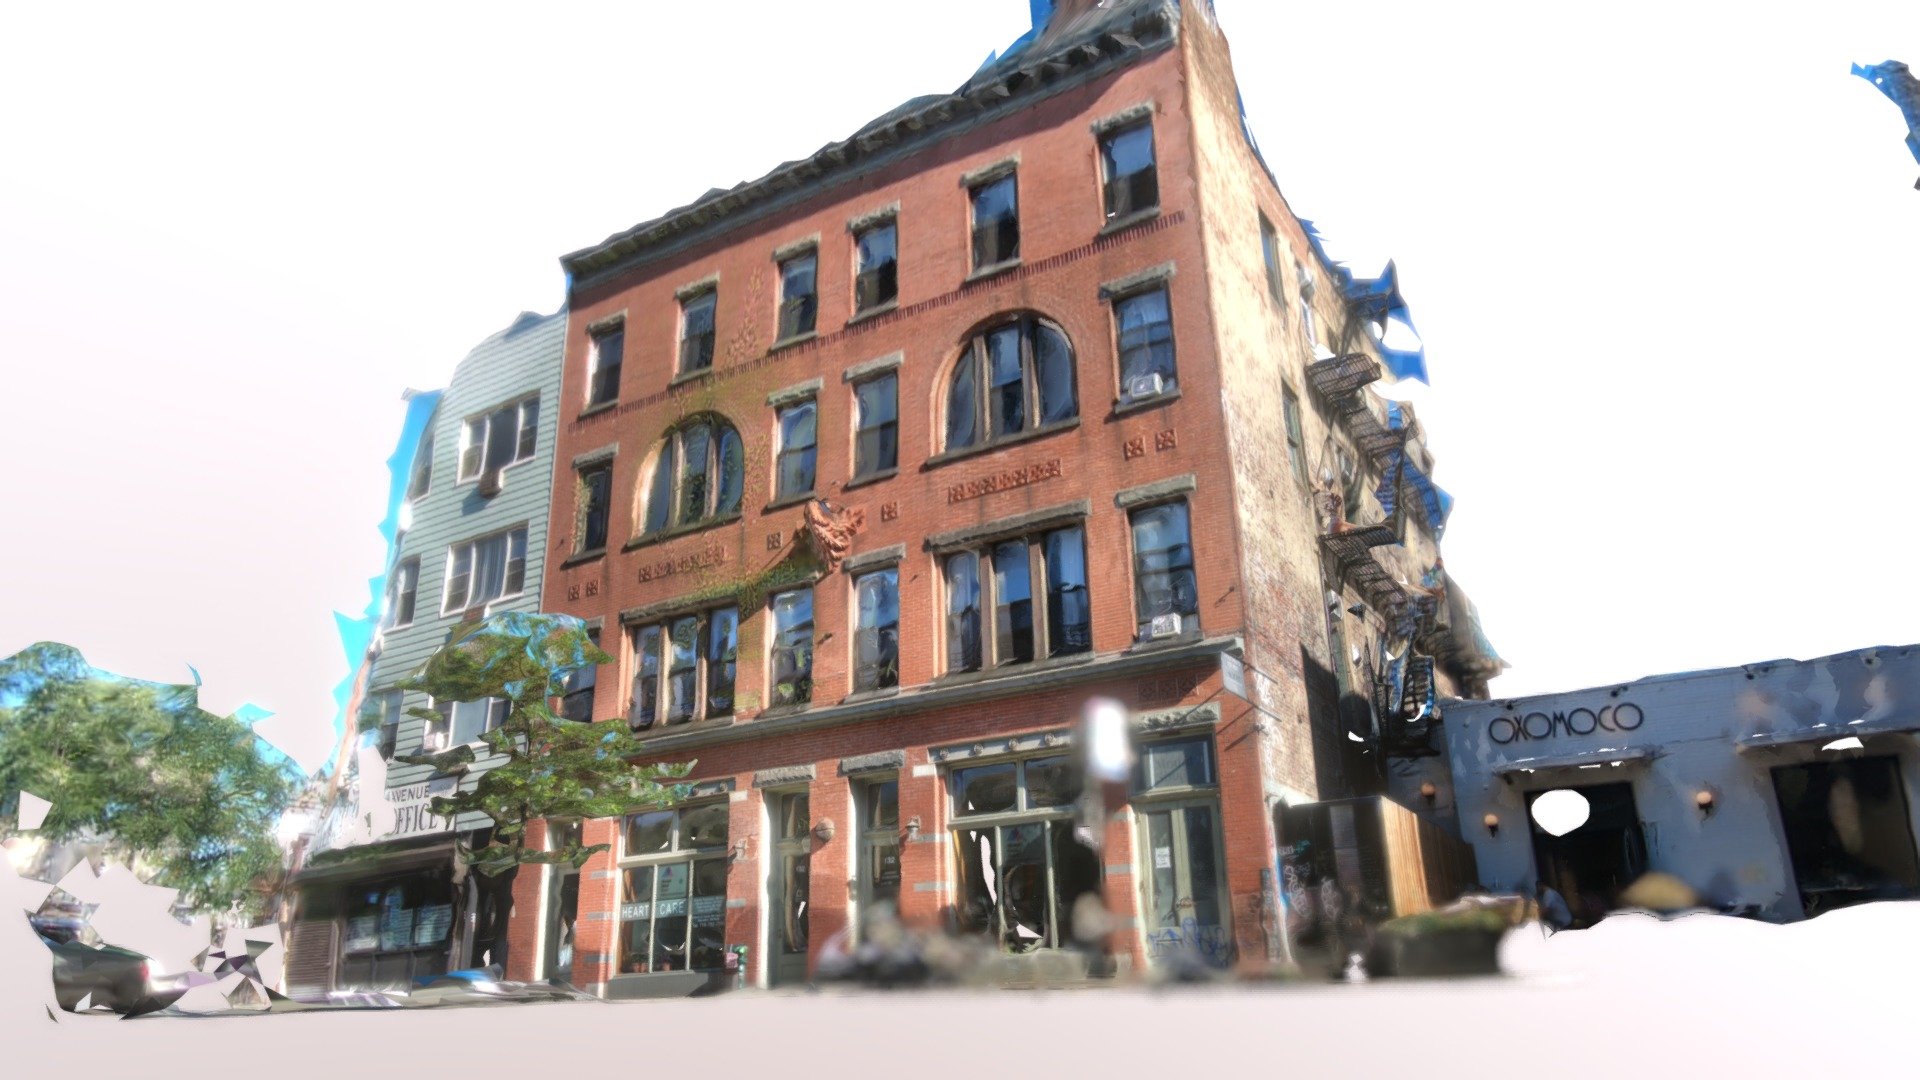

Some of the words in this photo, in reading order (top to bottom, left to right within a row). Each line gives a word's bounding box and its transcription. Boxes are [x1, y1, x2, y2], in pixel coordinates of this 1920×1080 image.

[1488, 702, 1645, 745] OXOMOCO
[621, 904, 649, 919] HEART
[660, 900, 685, 916] CARE
